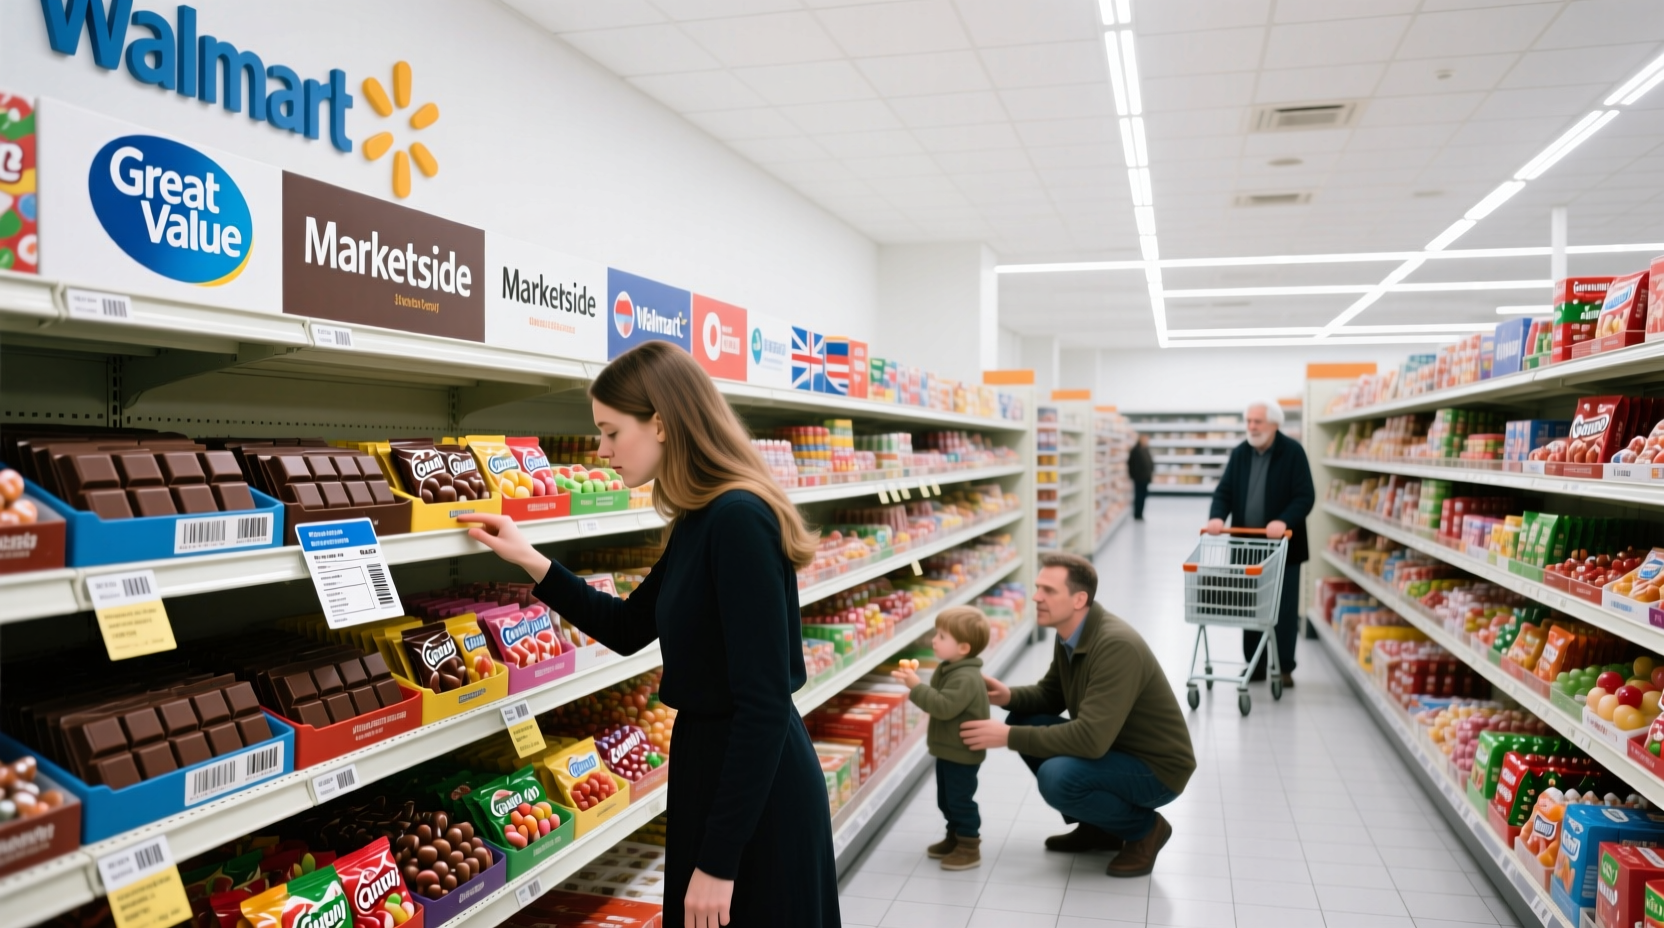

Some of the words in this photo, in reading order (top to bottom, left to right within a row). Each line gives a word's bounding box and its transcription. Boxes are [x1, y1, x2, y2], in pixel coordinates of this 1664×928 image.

[41, 0, 354, 153] Walmart
[109, 146, 220, 214] Great
[140, 200, 242, 258] Value
[304, 216, 472, 298] Marketside
[502, 266, 596, 318] Marketside
